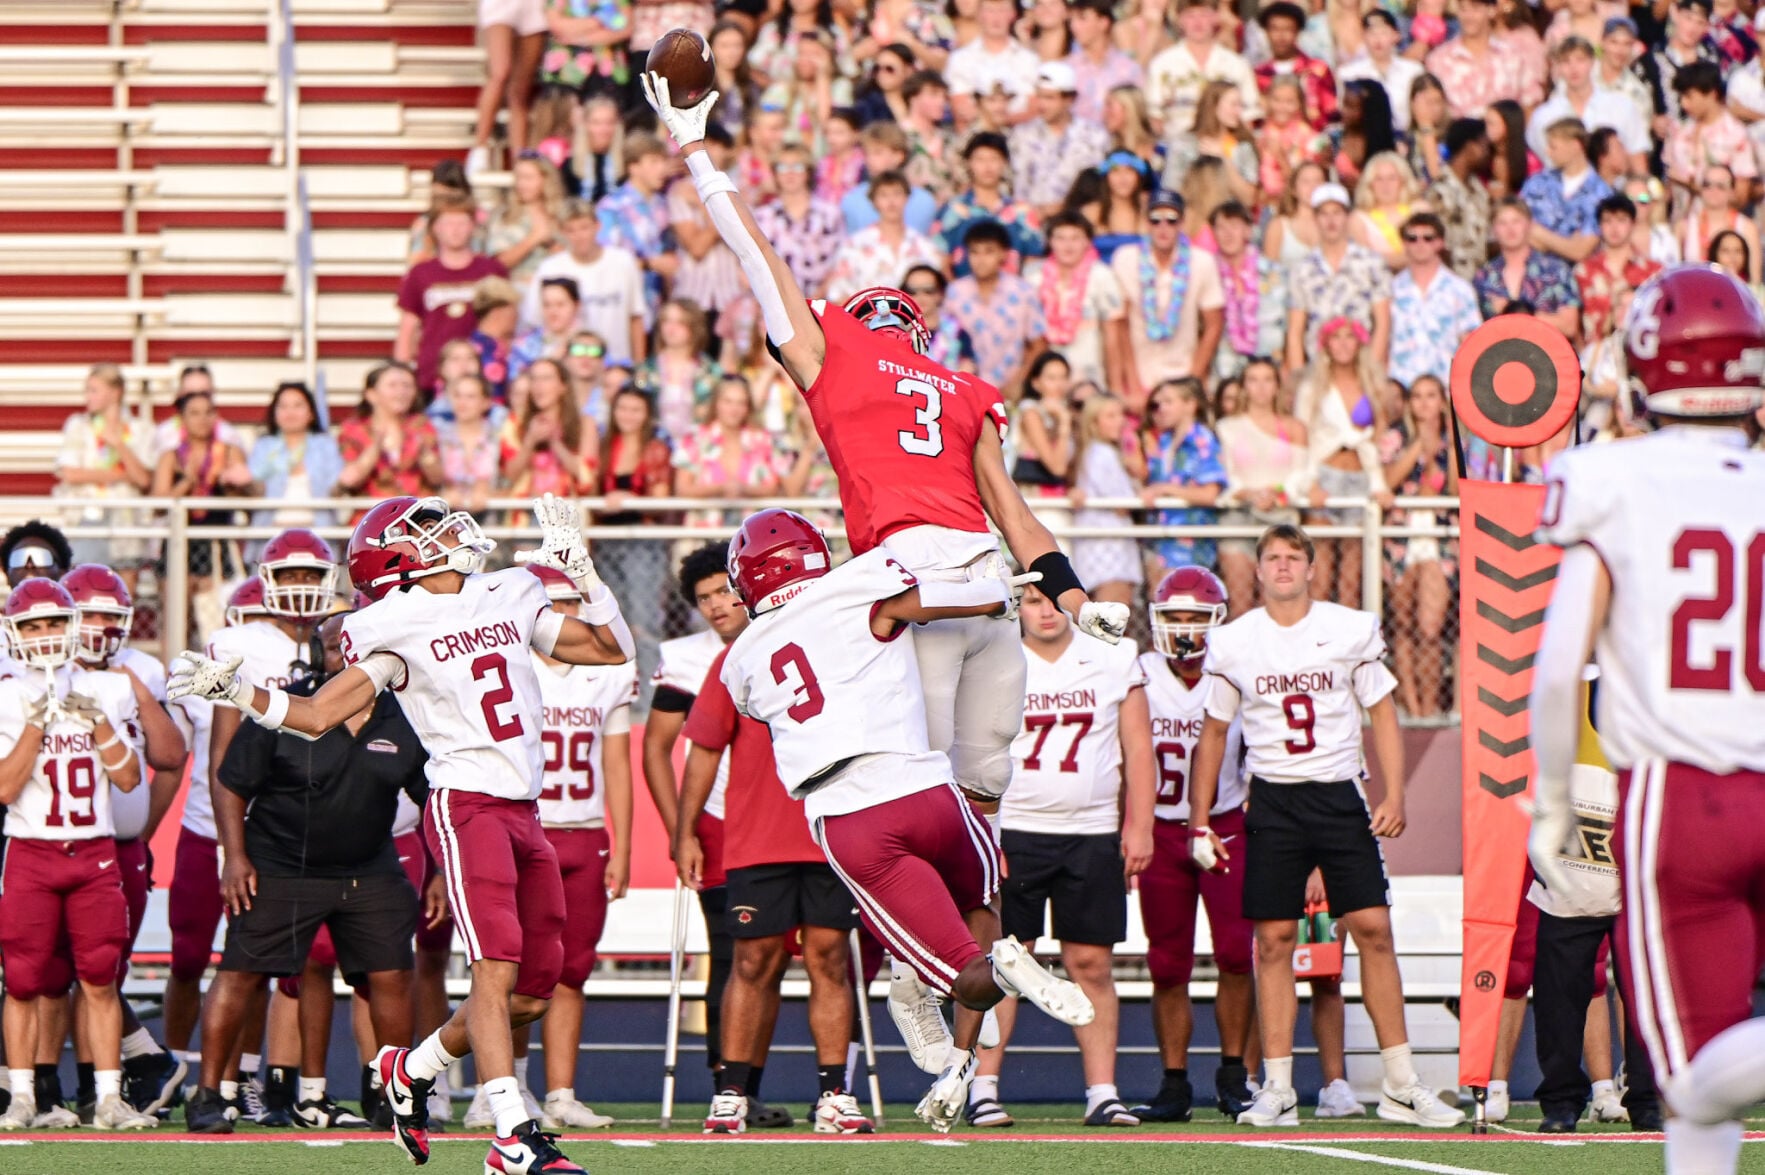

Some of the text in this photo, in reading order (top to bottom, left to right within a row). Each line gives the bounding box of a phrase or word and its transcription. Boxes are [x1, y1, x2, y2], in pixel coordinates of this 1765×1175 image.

[878, 359, 957, 395] STILLWATER
[895, 377, 944, 458] 3
[429, 620, 522, 662] CRIMSON
[471, 652, 524, 742] 2
[770, 641, 825, 724] 3
[1256, 671, 1333, 695] CRIMSON
[543, 707, 602, 726] RIMSON
[1151, 718, 1203, 738] CRIMS
[1282, 693, 1316, 755] 9
[1022, 712, 1094, 773] 77
[43, 757, 97, 827] 19
[1572, 800, 1614, 815] UBURBAN
[1292, 948, 1312, 972] G
